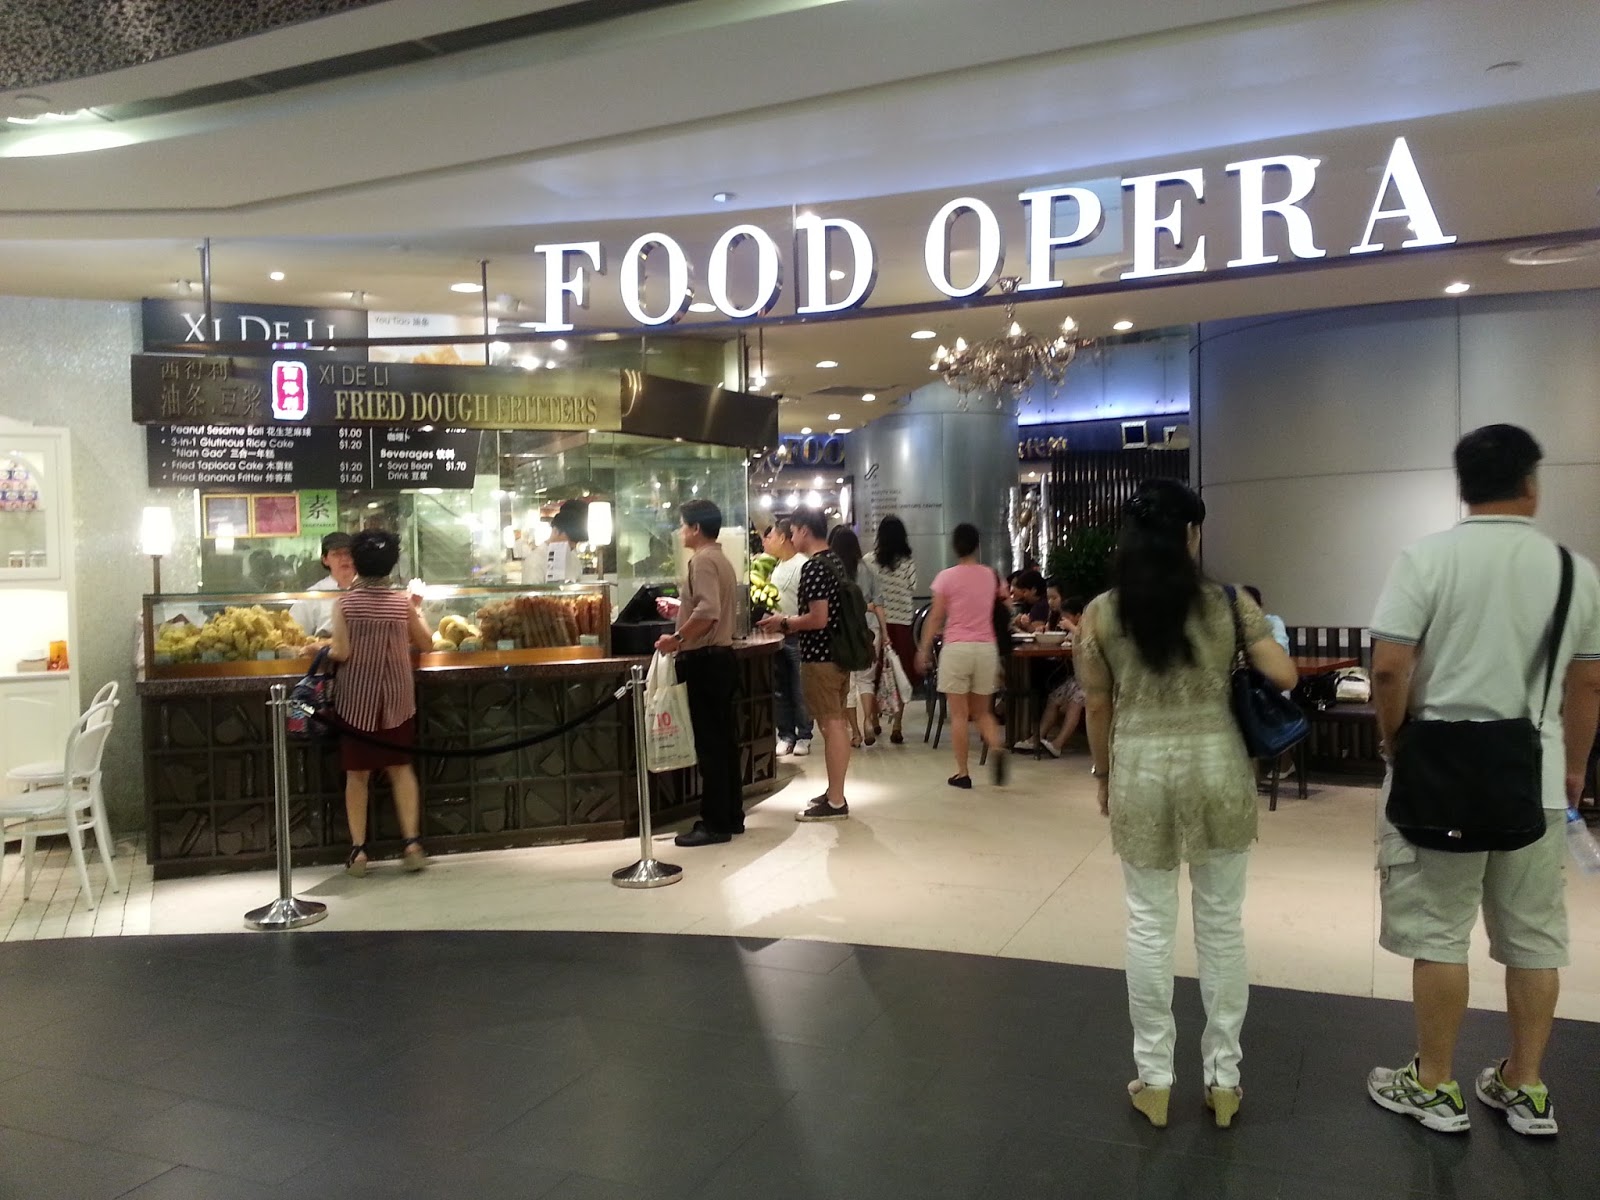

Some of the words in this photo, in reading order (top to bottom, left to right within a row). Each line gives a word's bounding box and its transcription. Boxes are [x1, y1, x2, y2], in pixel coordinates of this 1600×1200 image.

[534, 217, 876, 333] FOOD
[924, 136, 1457, 298] OPERA
[319, 364, 335, 384] XI
[342, 365, 366, 386] DE
[374, 366, 388, 386] LI
[334, 390, 406, 421] FRIED
[411, 391, 489, 423] DOUGH
[497, 392, 598, 425] FRITTERS
[170, 425, 204, 435] Peanut
[206, 426, 245, 436] Sesame
[247, 425, 264, 436] Ball
[338, 428, 362, 439] $1.00
[170, 438, 197, 447] 3-in-1
[200, 438, 244, 448] Glutinous
[246, 438, 267, 448] Rice
[269, 439, 294, 449] Cake
[339, 440, 362, 450] $1.20
[381, 449, 434, 460] Beverages
[171, 461, 196, 470] Fried
[198, 461, 236, 471] Tapioca
[238, 461, 264, 471] Cake
[340, 461, 363, 472] $1.20
[387, 461, 409, 472] Soya
[411, 461, 433, 471] Bean
[445, 461, 467, 472] $1.70
[172, 473, 196, 482] Fried
[198, 473, 236, 483] Banana
[238, 473, 264, 483] Fritter
[388, 472, 410, 481] Drink
[307, 494, 330, 520] 素
